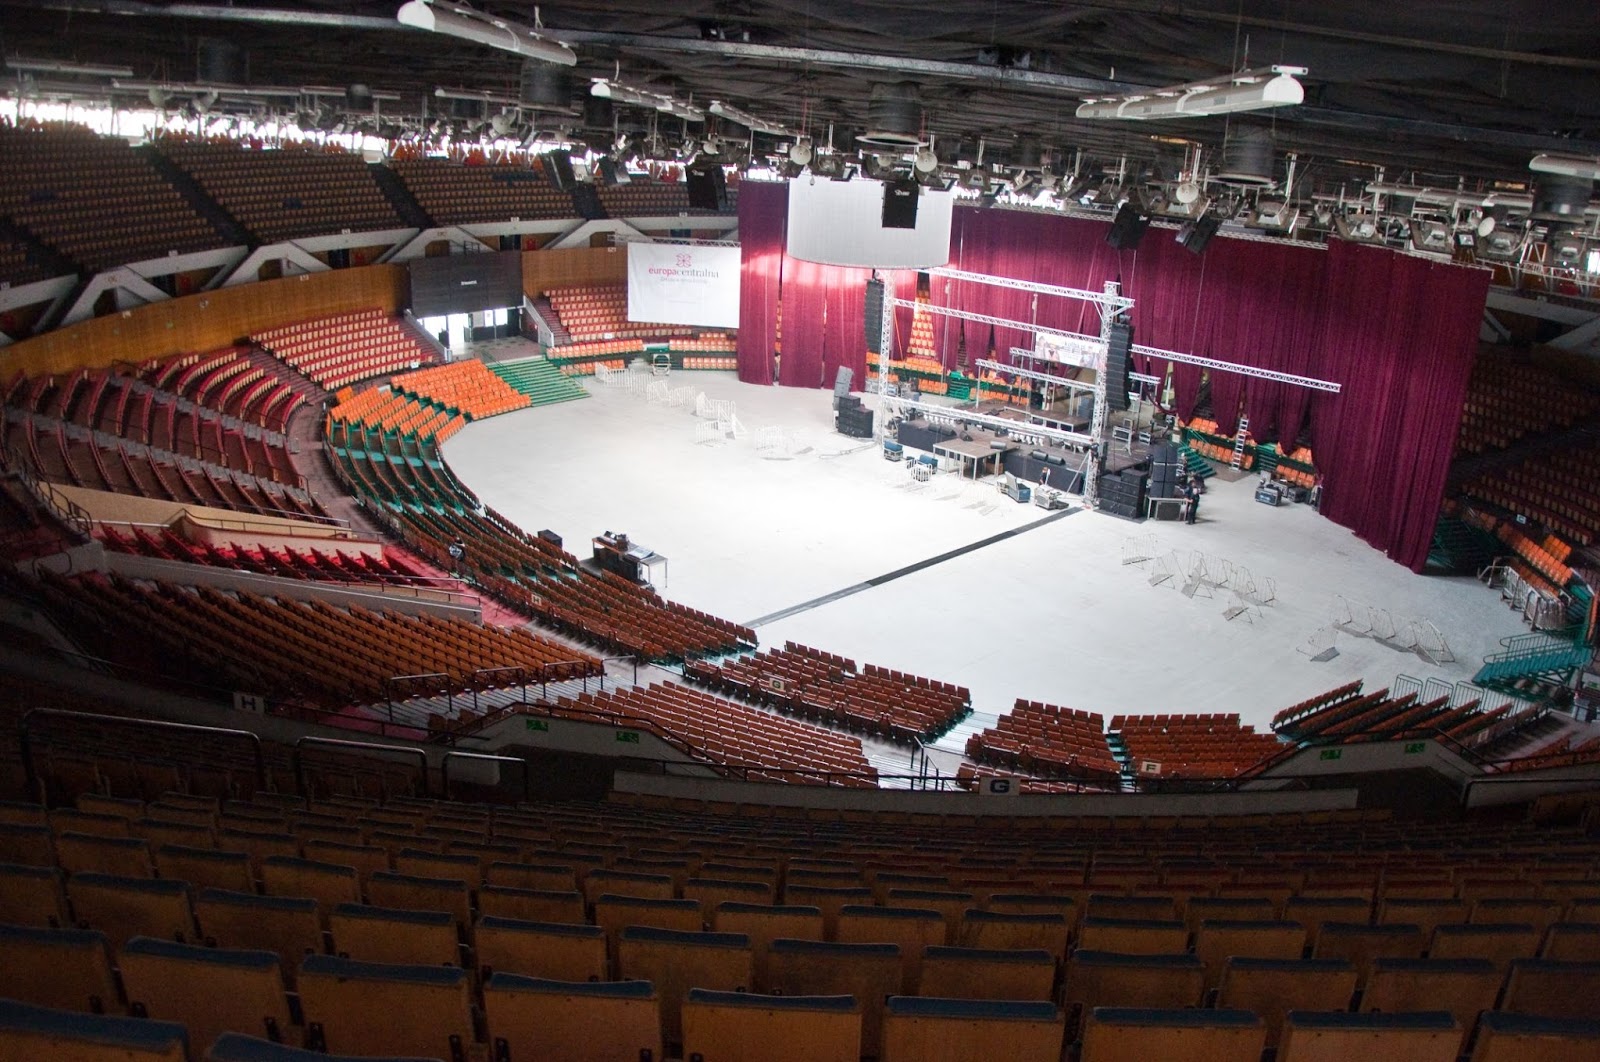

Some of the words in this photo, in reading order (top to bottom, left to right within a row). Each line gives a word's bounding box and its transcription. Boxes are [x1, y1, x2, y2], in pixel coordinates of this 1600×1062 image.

[241, 695, 256, 711] H
[1145, 763, 1157, 772] F
[990, 779, 1010, 793] G
